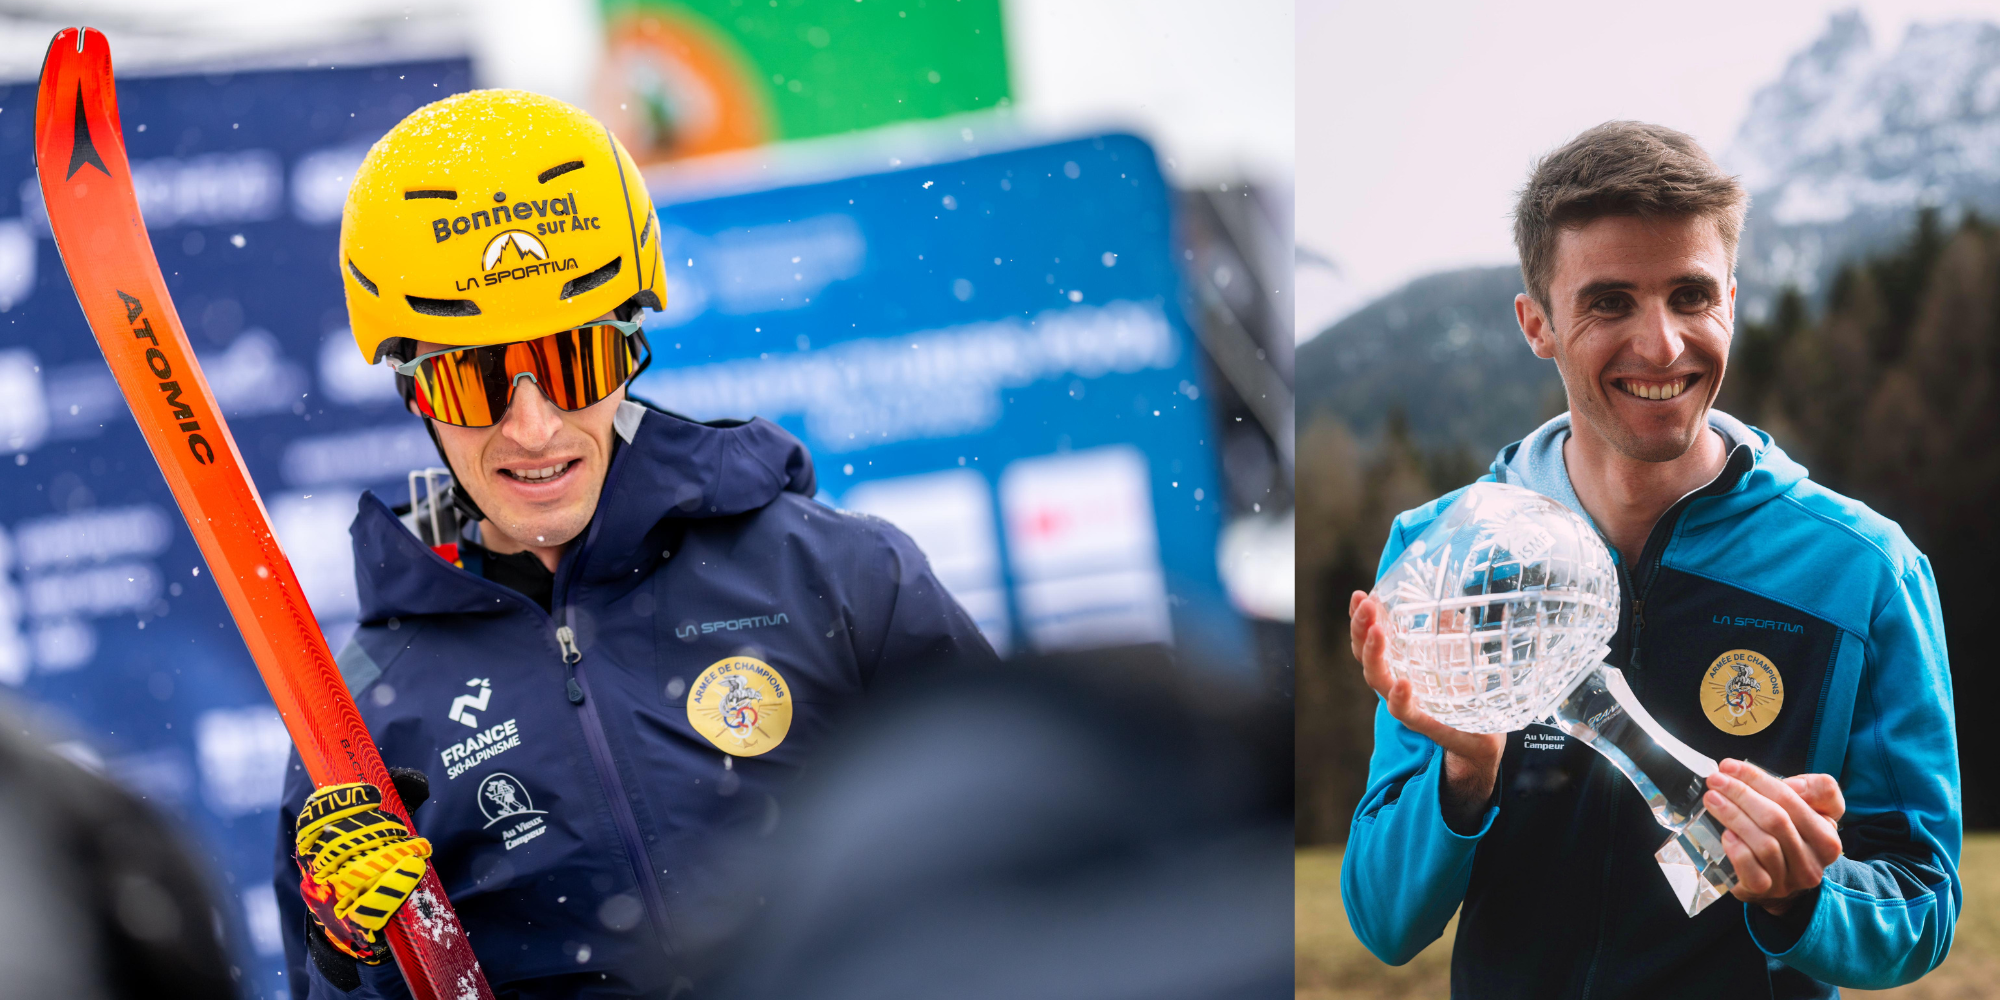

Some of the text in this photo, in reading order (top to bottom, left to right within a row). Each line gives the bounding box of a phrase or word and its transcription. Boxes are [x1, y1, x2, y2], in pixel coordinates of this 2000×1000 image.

[432, 192, 578, 243] Bonneval
[537, 215, 601, 236] sur Arc
[455, 257, 579, 292] LA SPORTIVA
[116, 289, 215, 466] ATOMIC
[675, 613, 788, 638] LA SPORTIVA
[1713, 615, 1804, 634] LA SPORTIVA
[717, 663, 732, 675] DE
[734, 662, 785, 699] CHAMPIONS
[1733, 653, 1745, 661] DE
[1747, 655, 1779, 694] CHAMPIONS
[440, 718, 518, 767] FRANCE
[1523, 741, 1565, 751] Campeur
[1524, 733, 1566, 742] Au Vieux
[447, 734, 521, 780] SKI-ALPINISME
[297, 786, 370, 827] RTIVA
[502, 817, 543, 840] Au Vieux
[504, 825, 547, 851] Campeur
